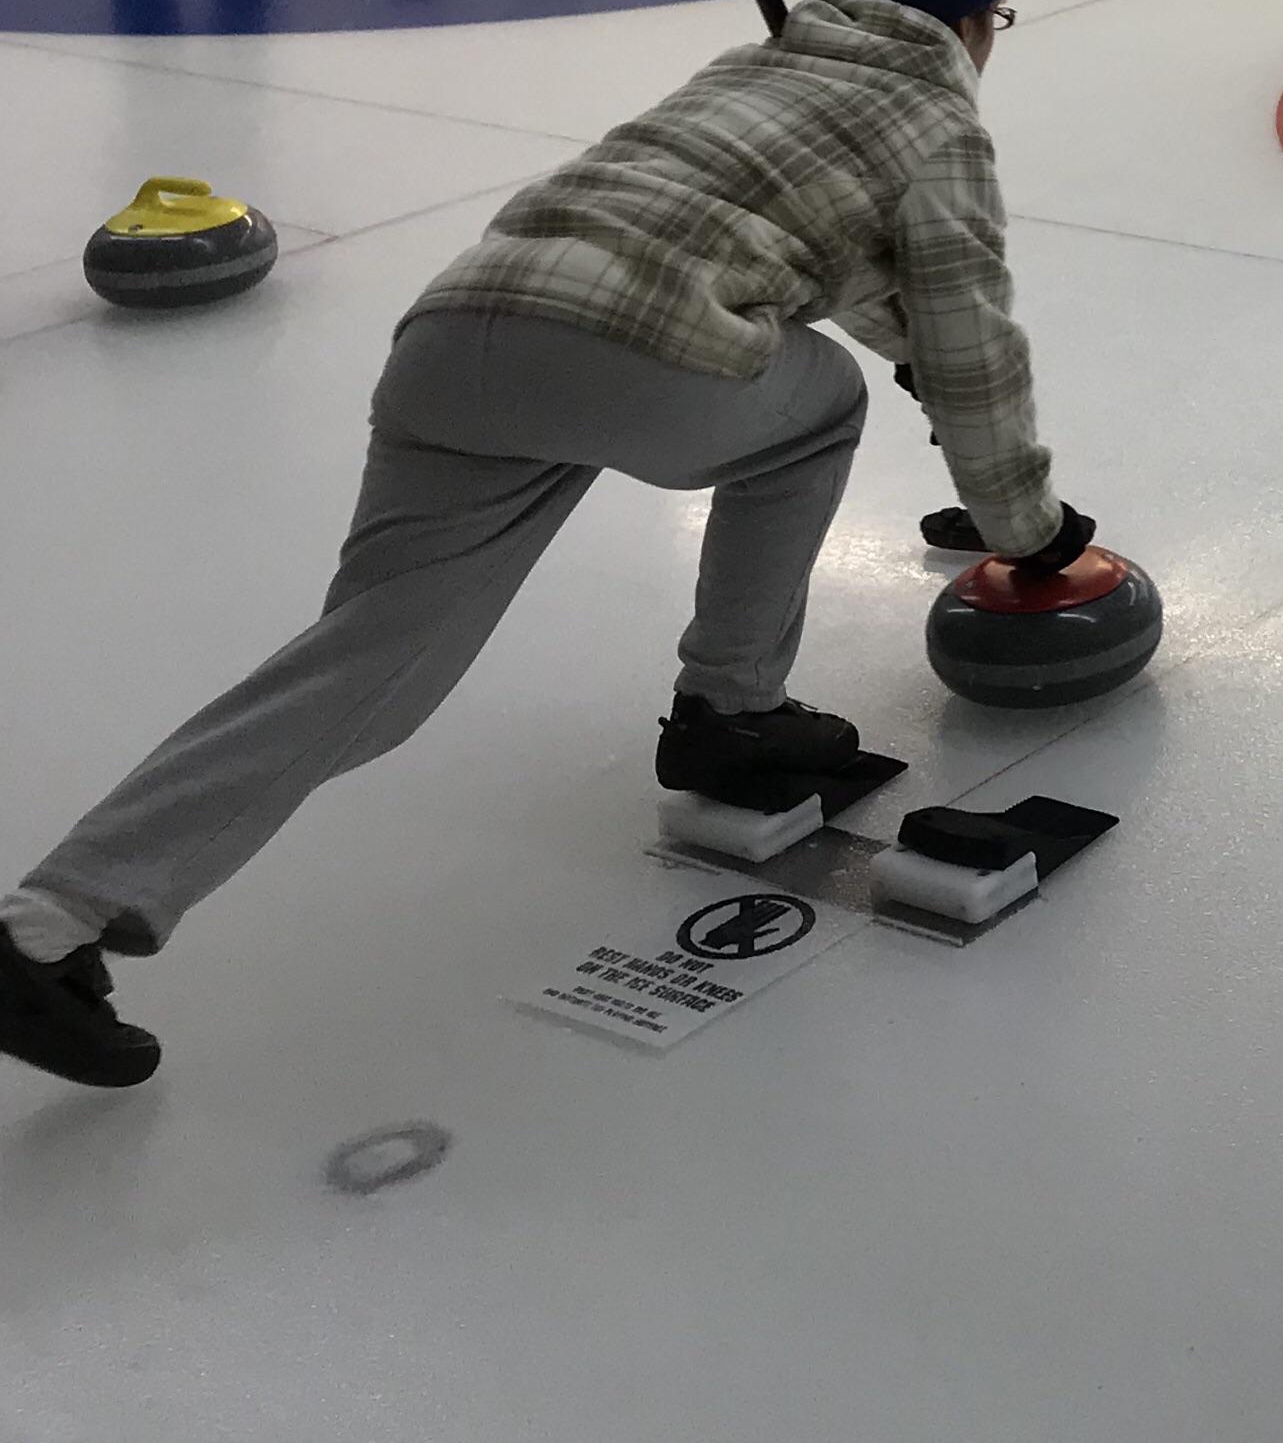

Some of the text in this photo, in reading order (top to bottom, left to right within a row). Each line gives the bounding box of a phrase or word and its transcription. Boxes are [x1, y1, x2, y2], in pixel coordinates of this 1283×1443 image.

[575, 961, 604, 975] ON
[598, 966, 631, 984] THE
[624, 976, 655, 994] ICE
[647, 984, 718, 1013] SURFACE
[588, 946, 744, 1003] REST HANDS OR KNEES
[655, 950, 715, 975] DO NOT
